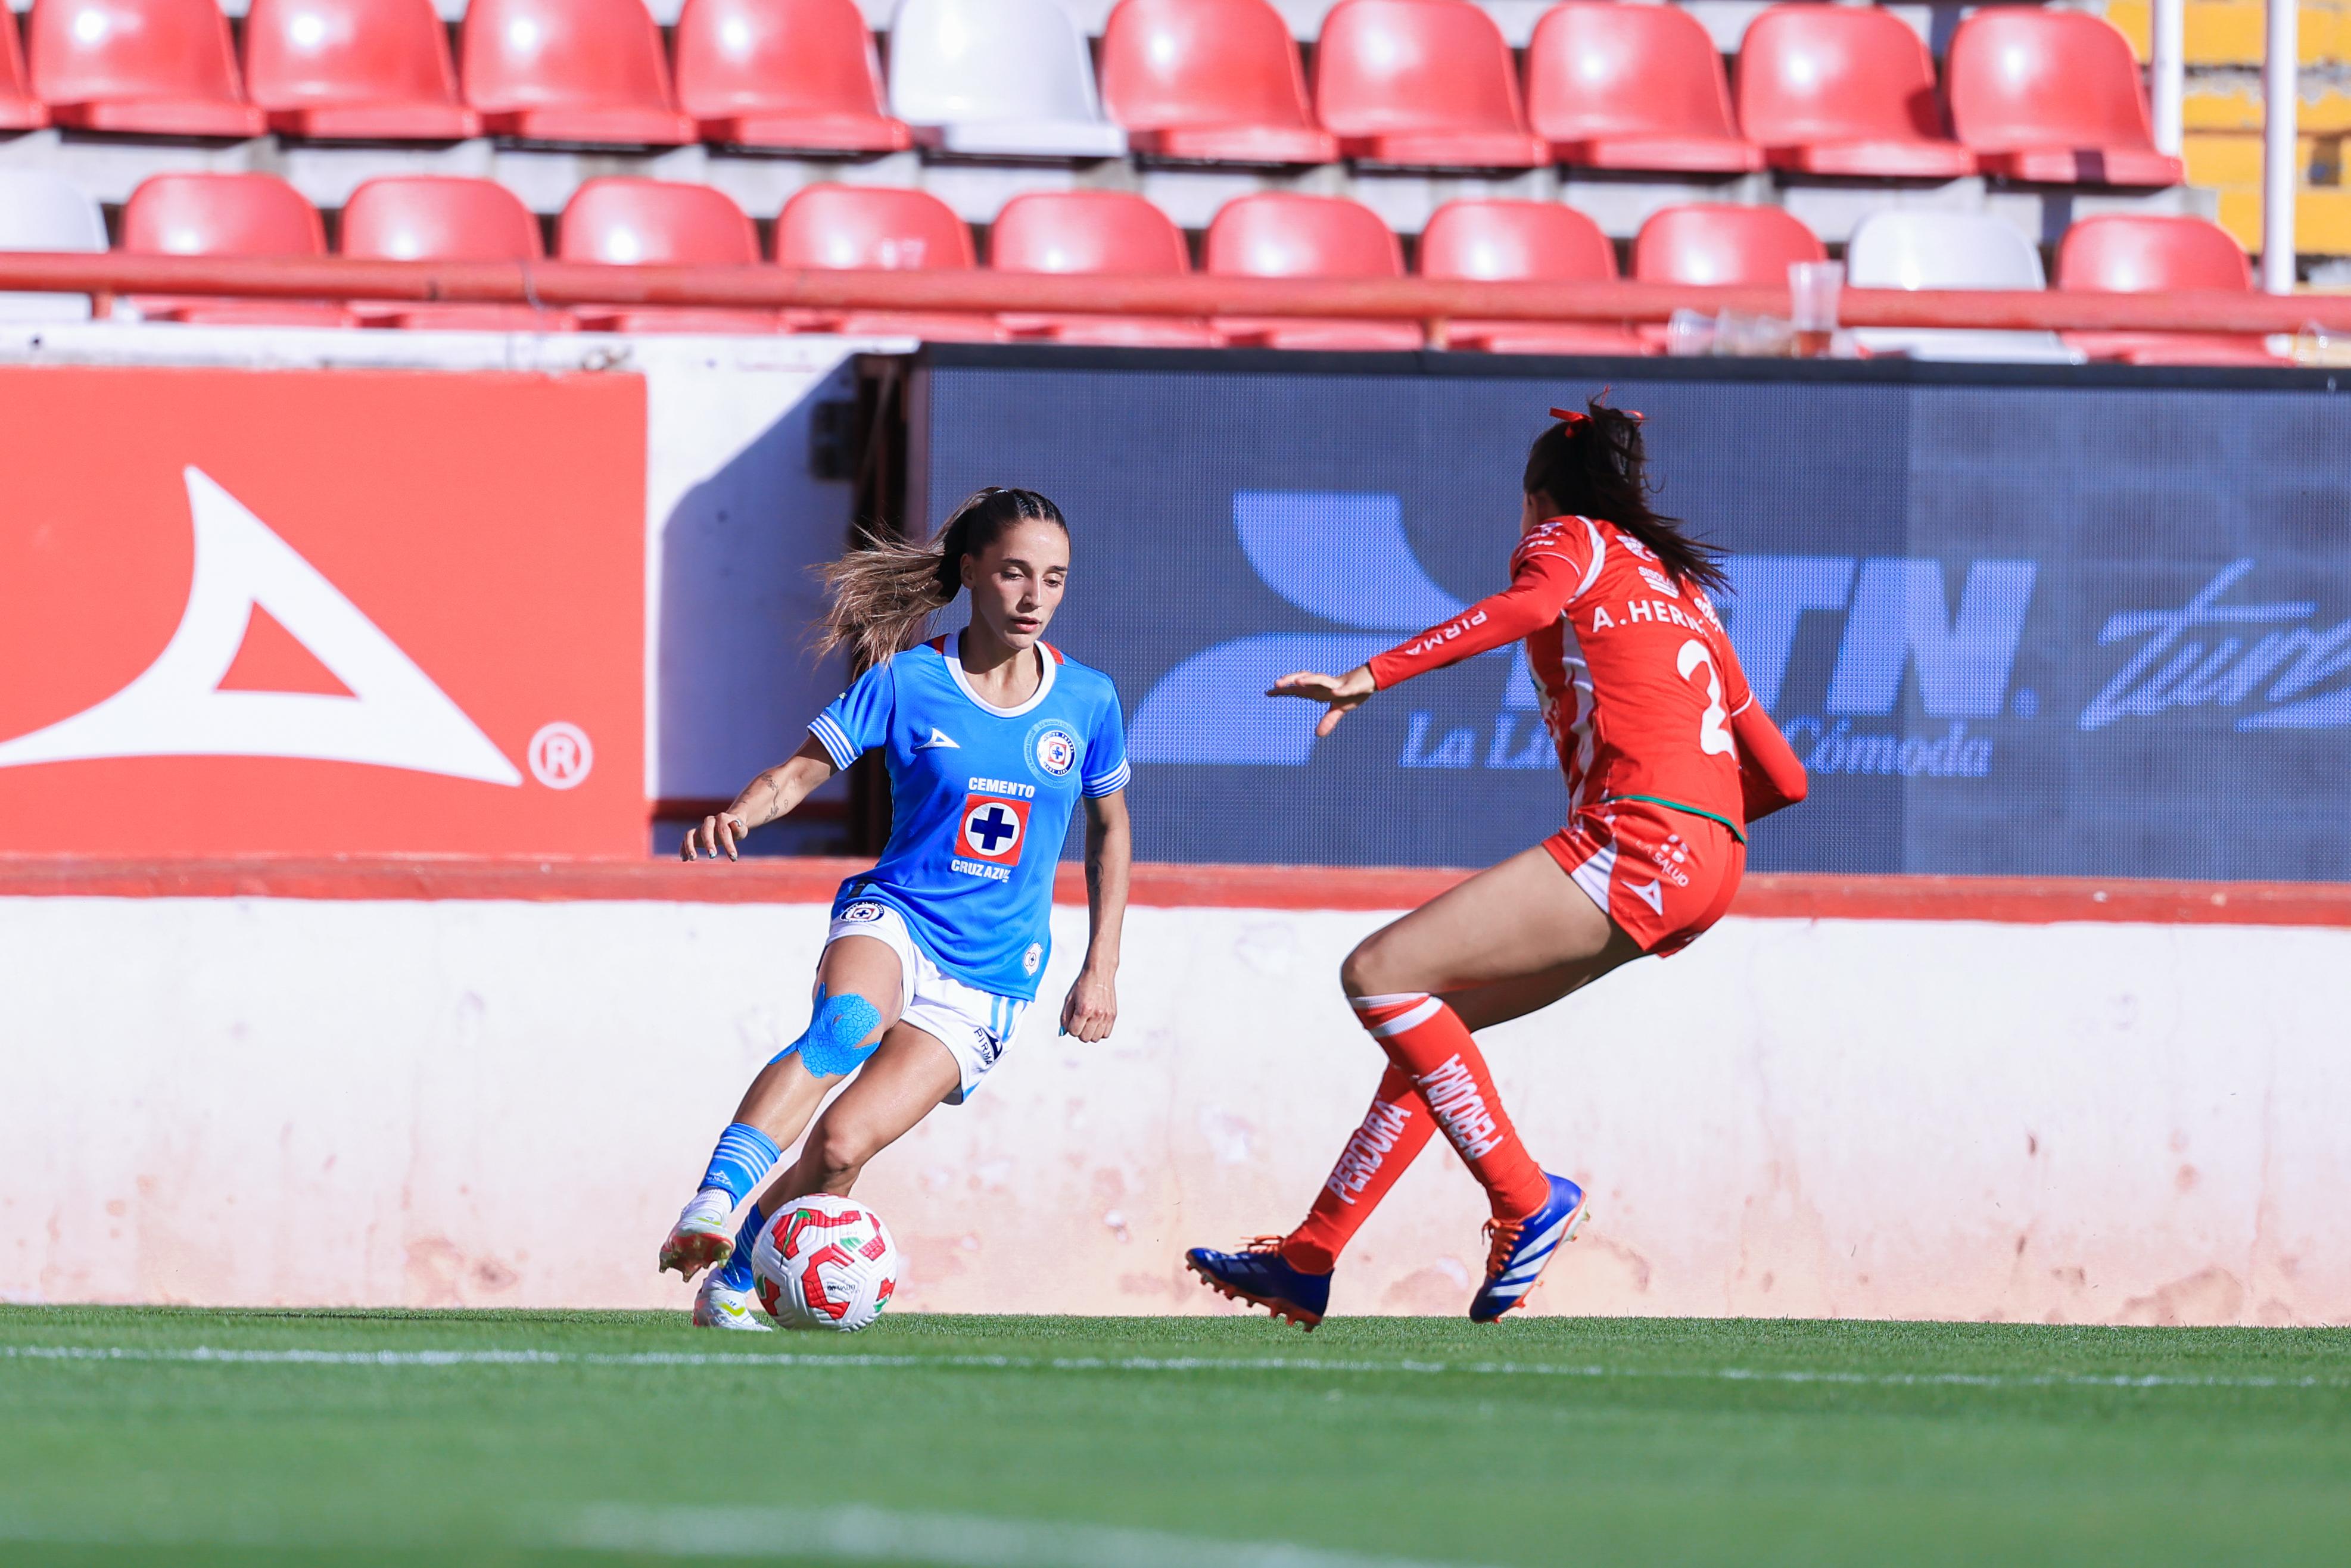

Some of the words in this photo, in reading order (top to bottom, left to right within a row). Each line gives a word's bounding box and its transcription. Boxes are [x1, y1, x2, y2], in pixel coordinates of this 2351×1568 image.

[1405, 610, 1488, 656] PIRMA
[1676, 638, 1736, 762] 2
[1398, 710, 1475, 769] La
[968, 777, 1035, 799] CEMENTO
[951, 859, 983, 877] CRUZ
[1652, 852, 1690, 888] SALUD
[973, 1027, 994, 1067] PIRMA
[1418, 1053, 1504, 1161] PERDURA
[1326, 1100, 1413, 1206] PERDURA
